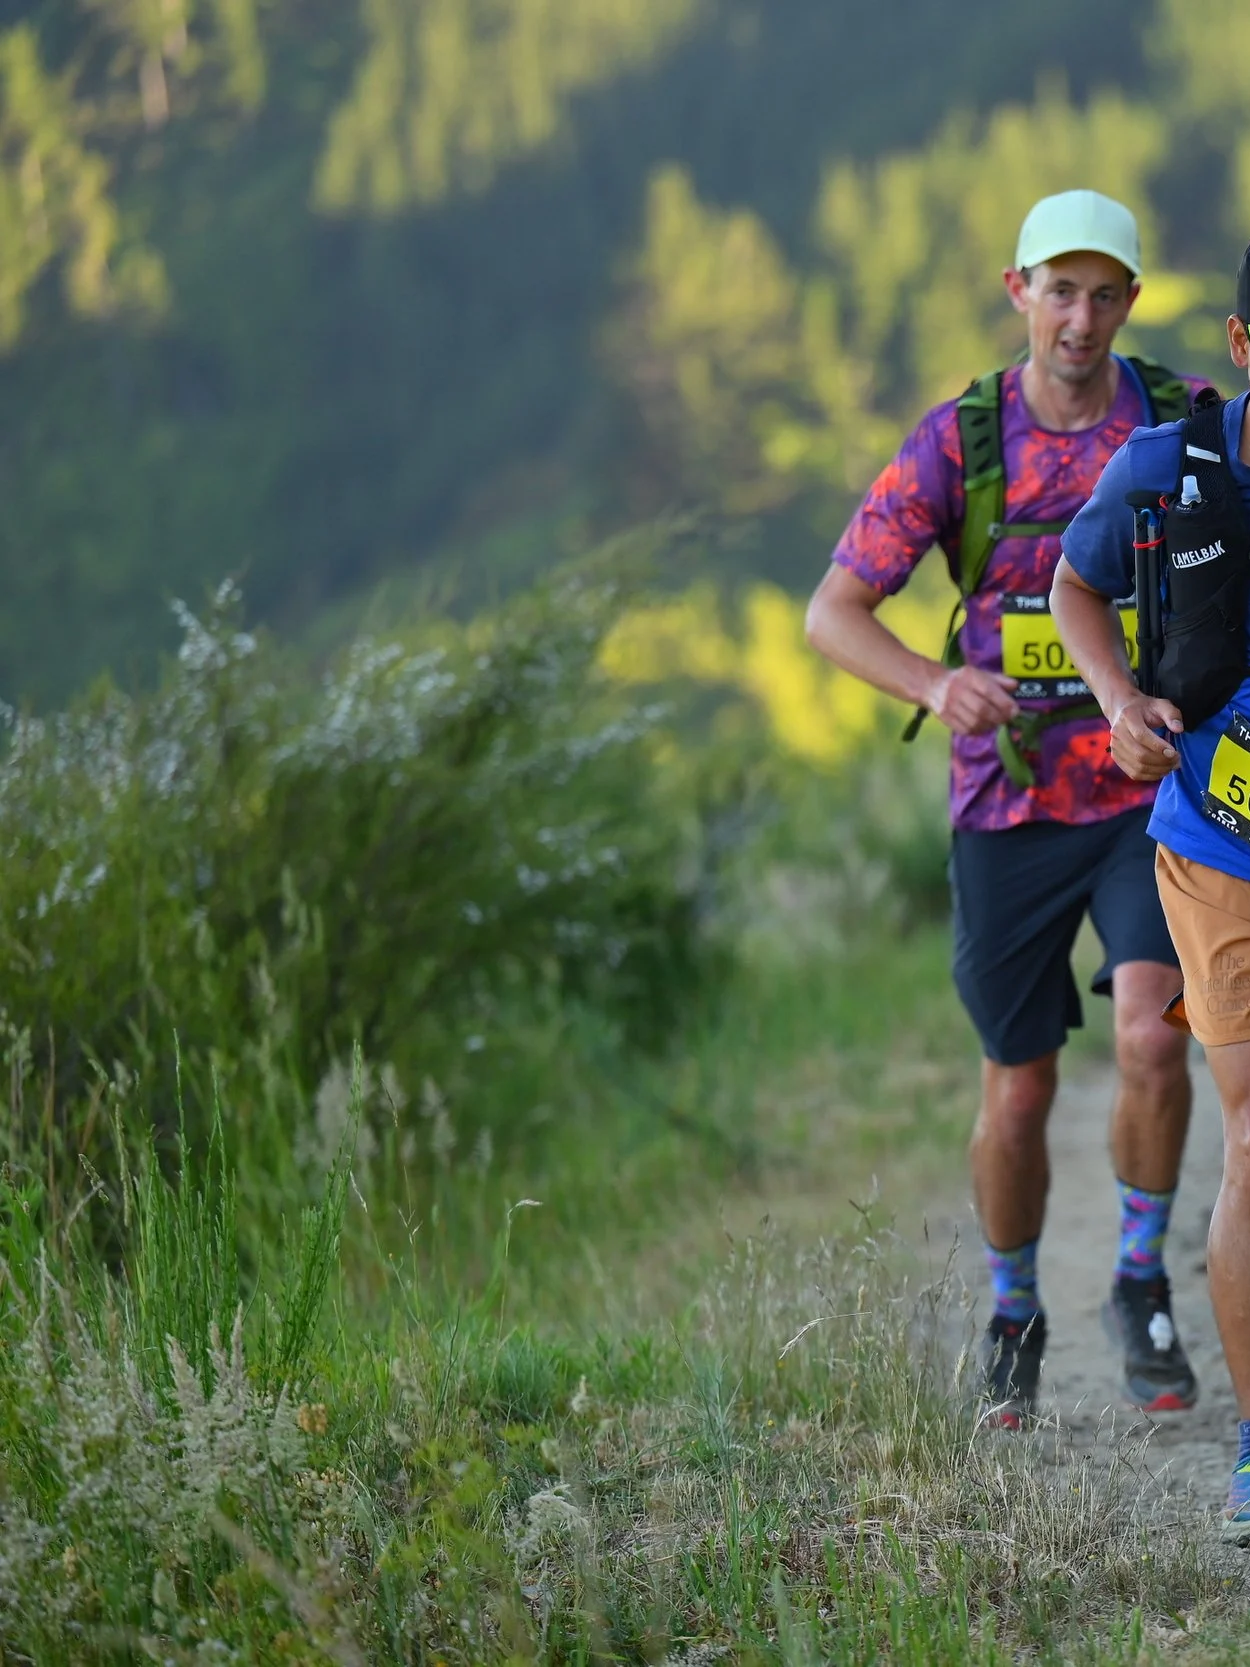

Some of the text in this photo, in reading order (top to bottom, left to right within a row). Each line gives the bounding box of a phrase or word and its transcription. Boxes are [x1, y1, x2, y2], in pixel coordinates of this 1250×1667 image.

[1171, 539, 1226, 569] CAMELBAK
[1015, 596, 1046, 609] THE
[1211, 812, 1240, 834] OAKLEY
[1216, 952, 1245, 970] The
